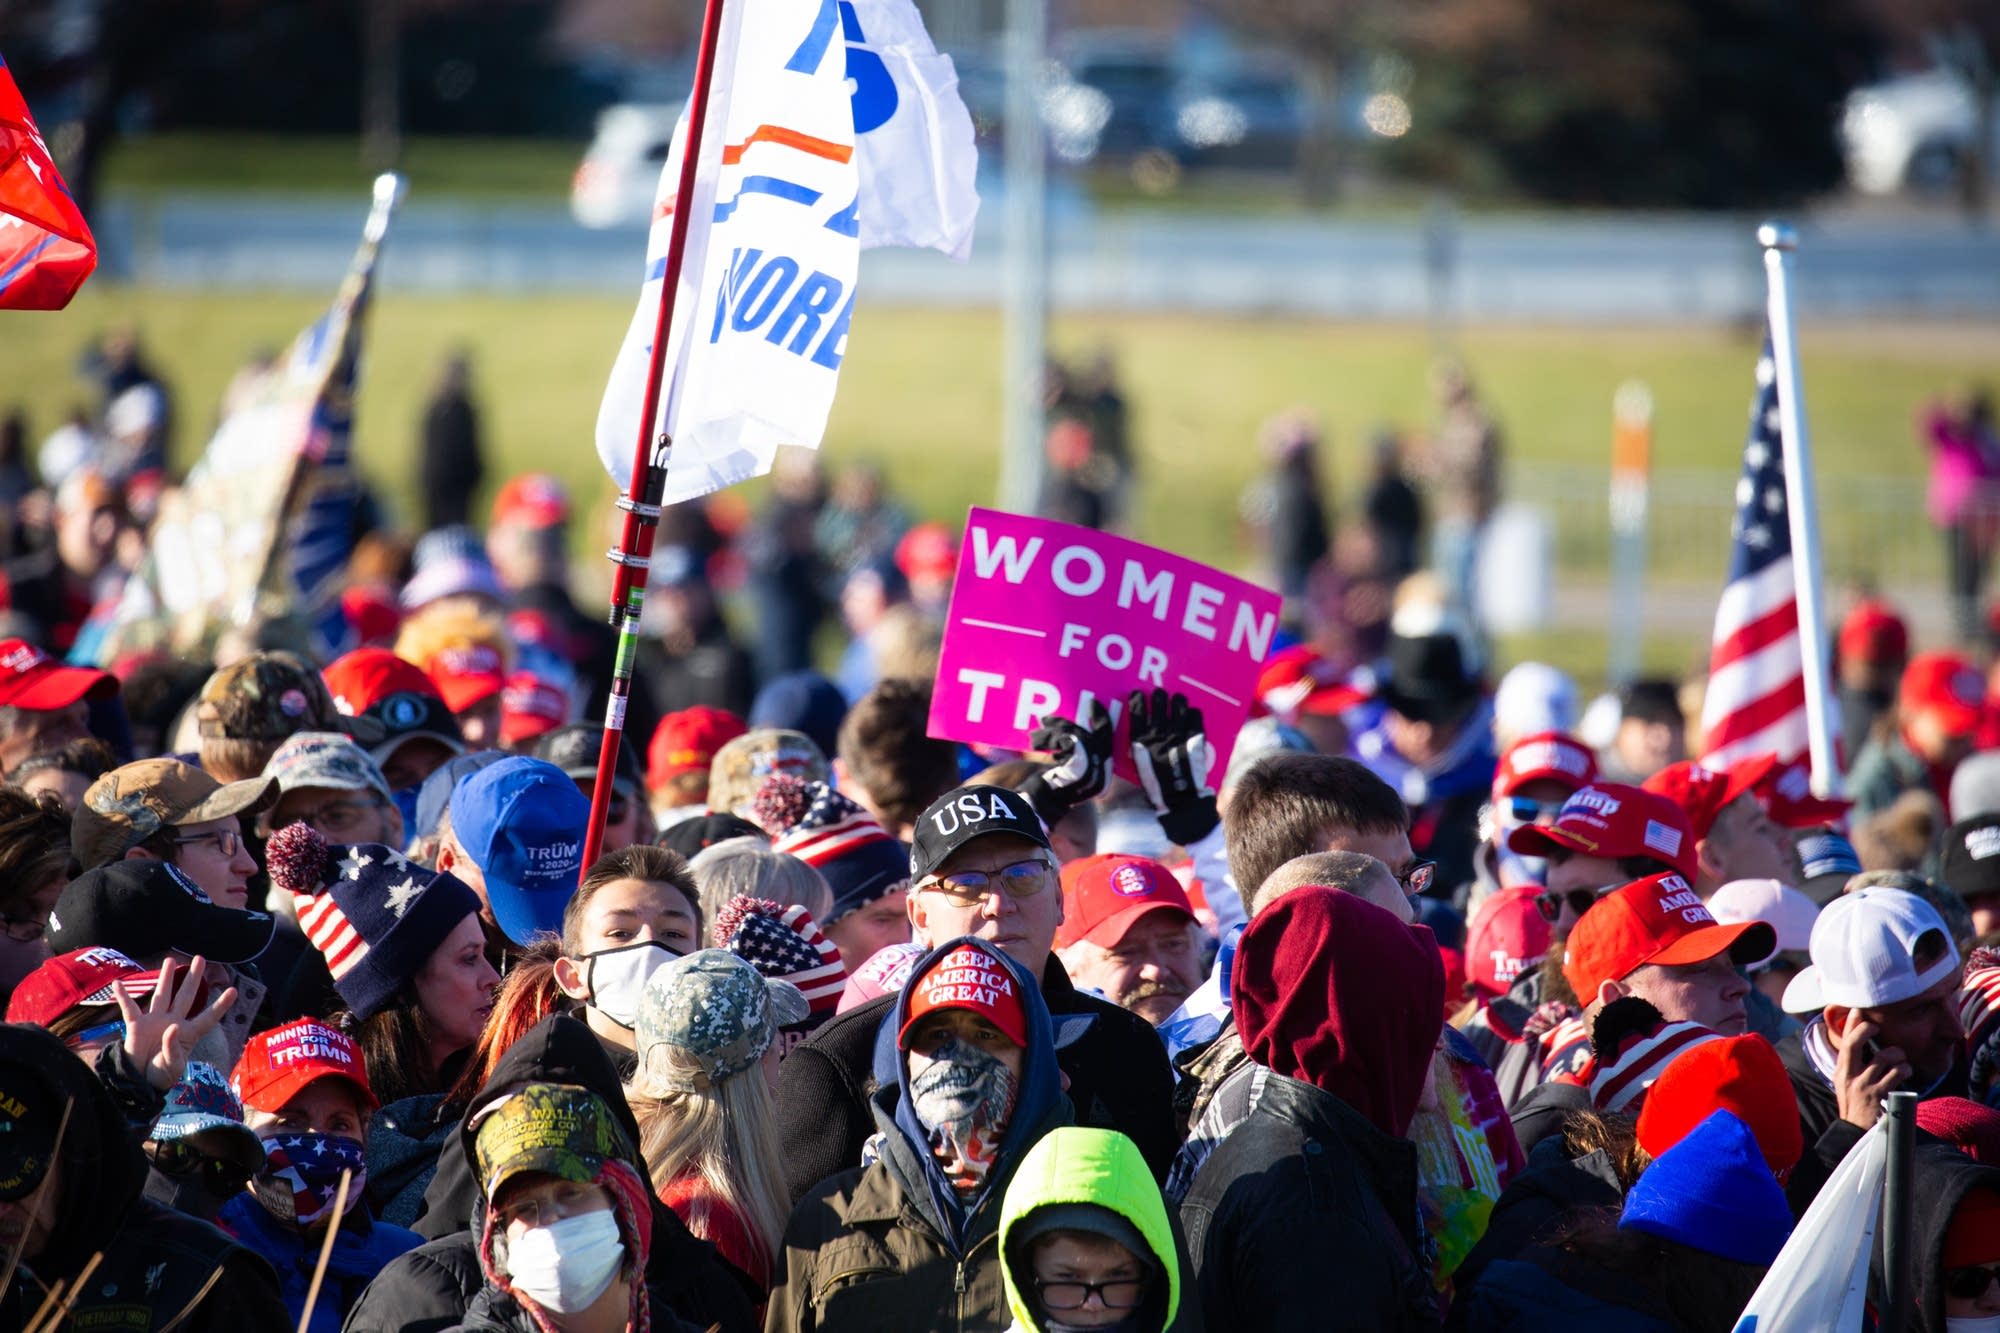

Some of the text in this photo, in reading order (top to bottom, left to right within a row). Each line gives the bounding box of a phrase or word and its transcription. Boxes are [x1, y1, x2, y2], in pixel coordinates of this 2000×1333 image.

[971, 526, 1276, 663] WOMEN
[1059, 622, 1168, 687] FOR
[931, 793, 1017, 836] USA
[527, 840, 580, 860] TRUM
[940, 950, 997, 971] KEEP
[918, 966, 1014, 998] AMERICA
[927, 984, 999, 1008] GREAT
[266, 1023, 352, 1049] MINNESOTA
[300, 1035, 329, 1045] FOR
[271, 1044, 352, 1065] TRUMP
[532, 1107, 578, 1121] WALL
